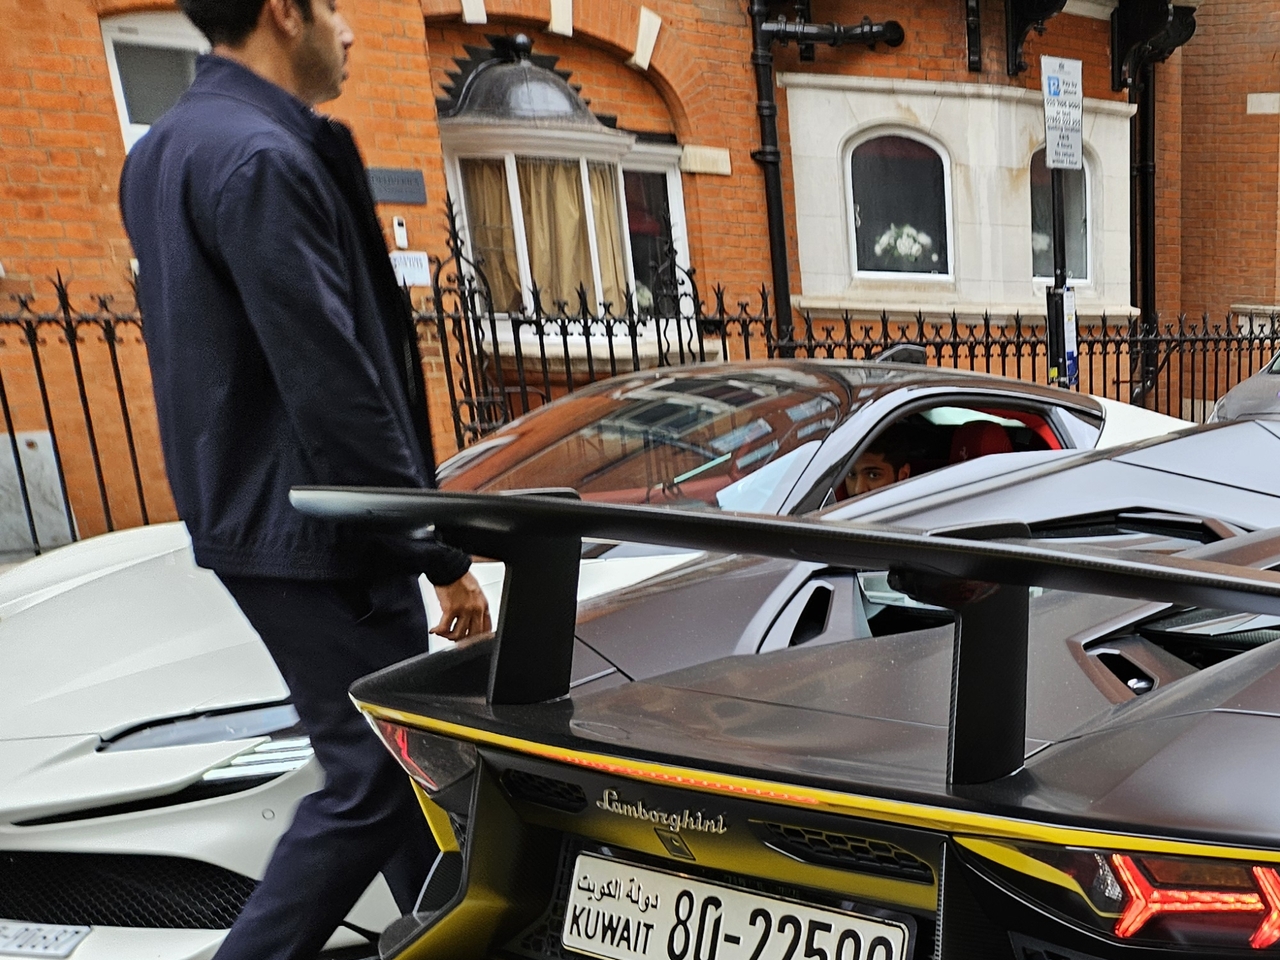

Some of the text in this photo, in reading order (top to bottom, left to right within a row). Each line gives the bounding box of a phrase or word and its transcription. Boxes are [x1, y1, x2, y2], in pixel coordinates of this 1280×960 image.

[596, 788, 728, 835] Lamborghini
[577, 874, 661, 913] دولة الكويت
[568, 904, 656, 956] KUWAIT
